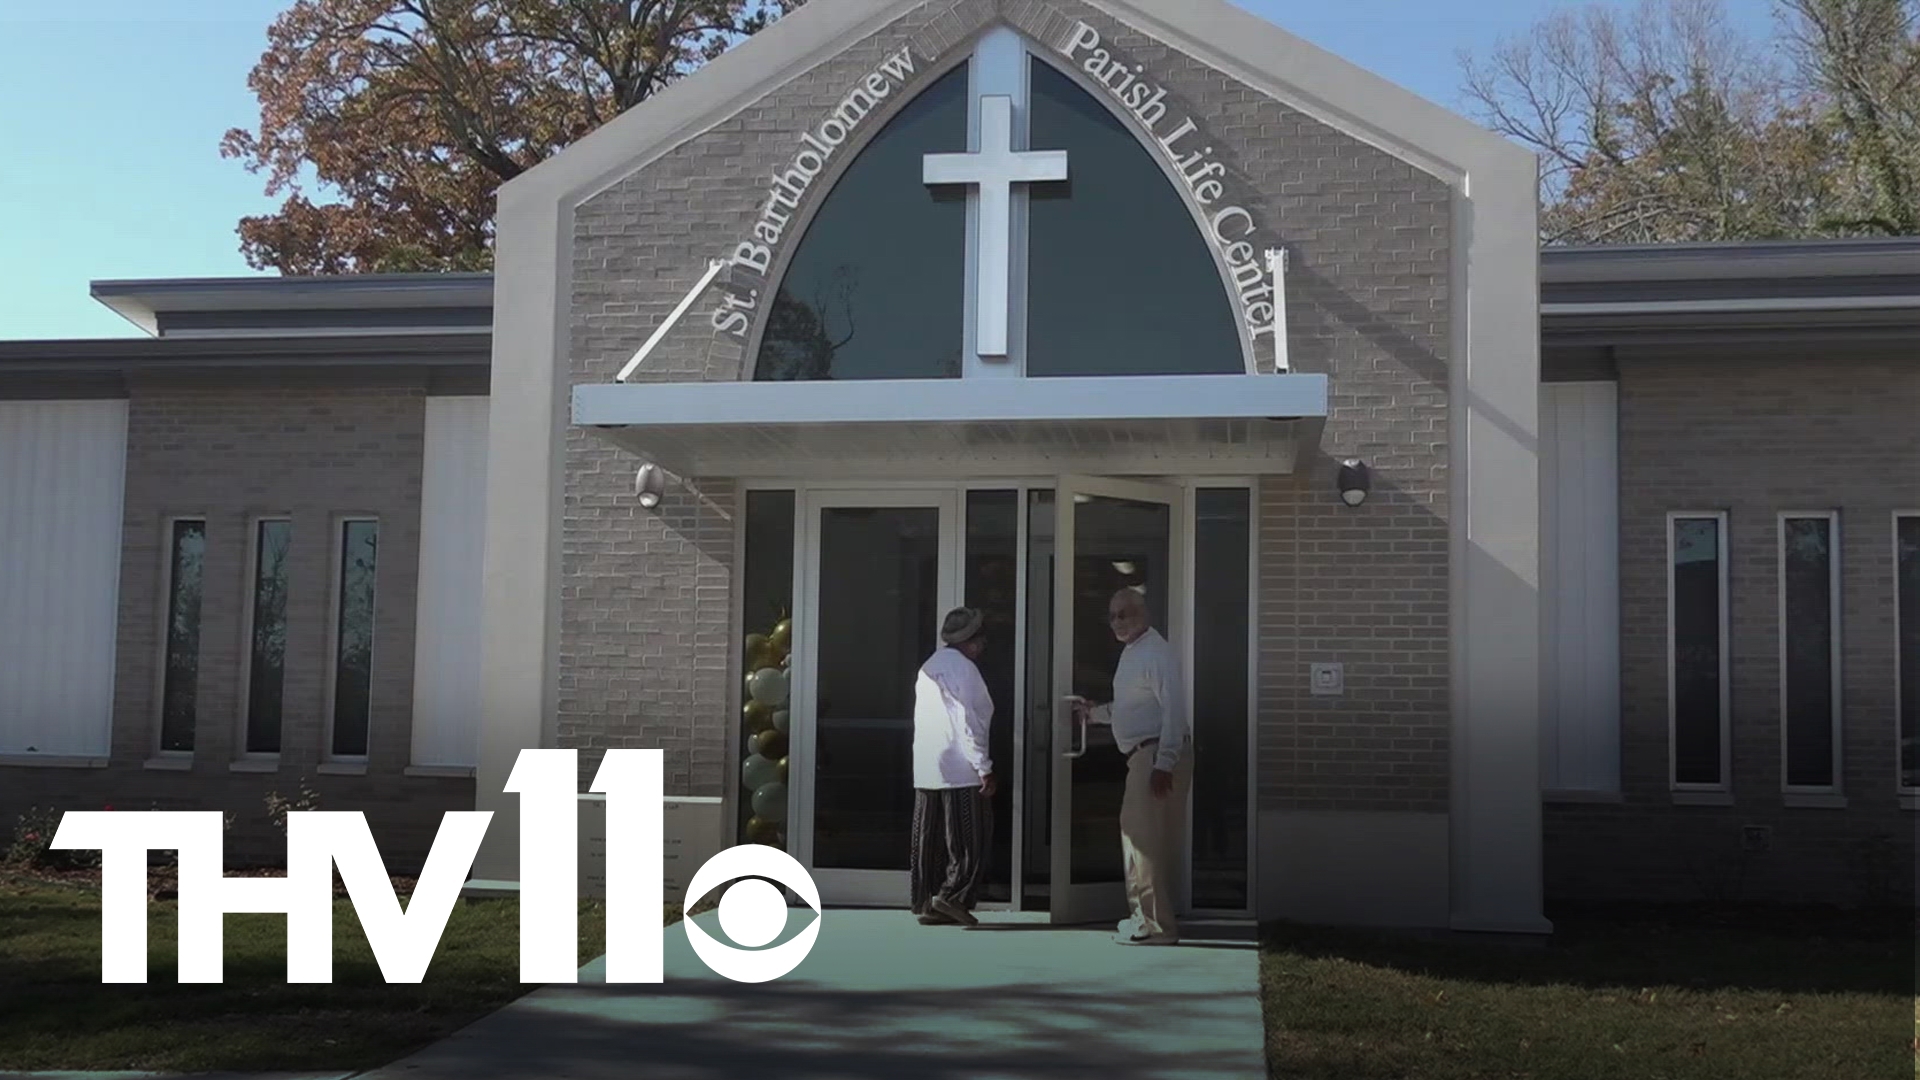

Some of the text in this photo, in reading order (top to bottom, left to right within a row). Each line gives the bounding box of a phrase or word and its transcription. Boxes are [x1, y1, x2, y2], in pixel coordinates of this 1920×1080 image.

[711, 20, 1276, 340] St. Bartholomew Parish Life Center
